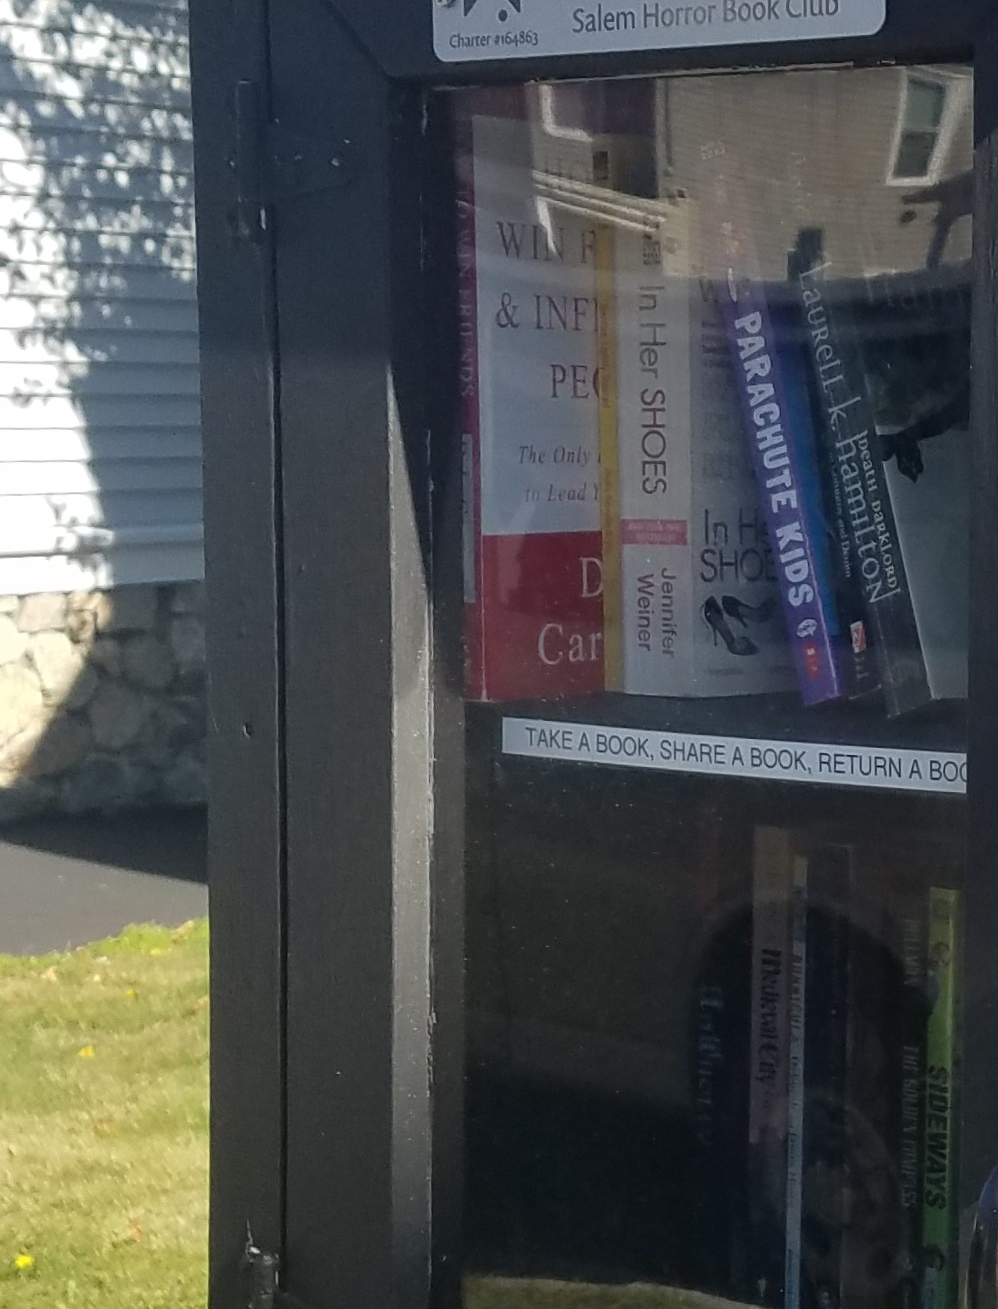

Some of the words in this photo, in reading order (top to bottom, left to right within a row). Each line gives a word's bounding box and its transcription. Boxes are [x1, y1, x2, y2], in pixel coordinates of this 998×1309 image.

[449, 32, 491, 48] Charter
[571, 3, 636, 33] Salem
[496, 220, 564, 263] WIN
[495, 291, 520, 330] &
[639, 285, 665, 312] In
[639, 322, 666, 379] Her
[519, 444, 546, 465] The
[553, 444, 591, 468] Only
[639, 387, 668, 495] SHOES
[733, 310, 798, 515] PARACHUTE
[775, 521, 816, 609] KIDS
[704, 507, 729, 546] In
[636, 573, 656, 653] Weiner
[660, 566, 678, 659] Jennifer
[525, 726, 574, 750] TAKE
[578, 730, 591, 753] A
[595, 733, 655, 762] BOOK,
[659, 739, 726, 766] SHARE
[731, 744, 745, 767] A
[750, 747, 813, 775] BOOK,
[818, 752, 902, 779] RETURN
[909, 759, 923, 779] A
[923, 1064, 949, 1212] SIDEWAYS
